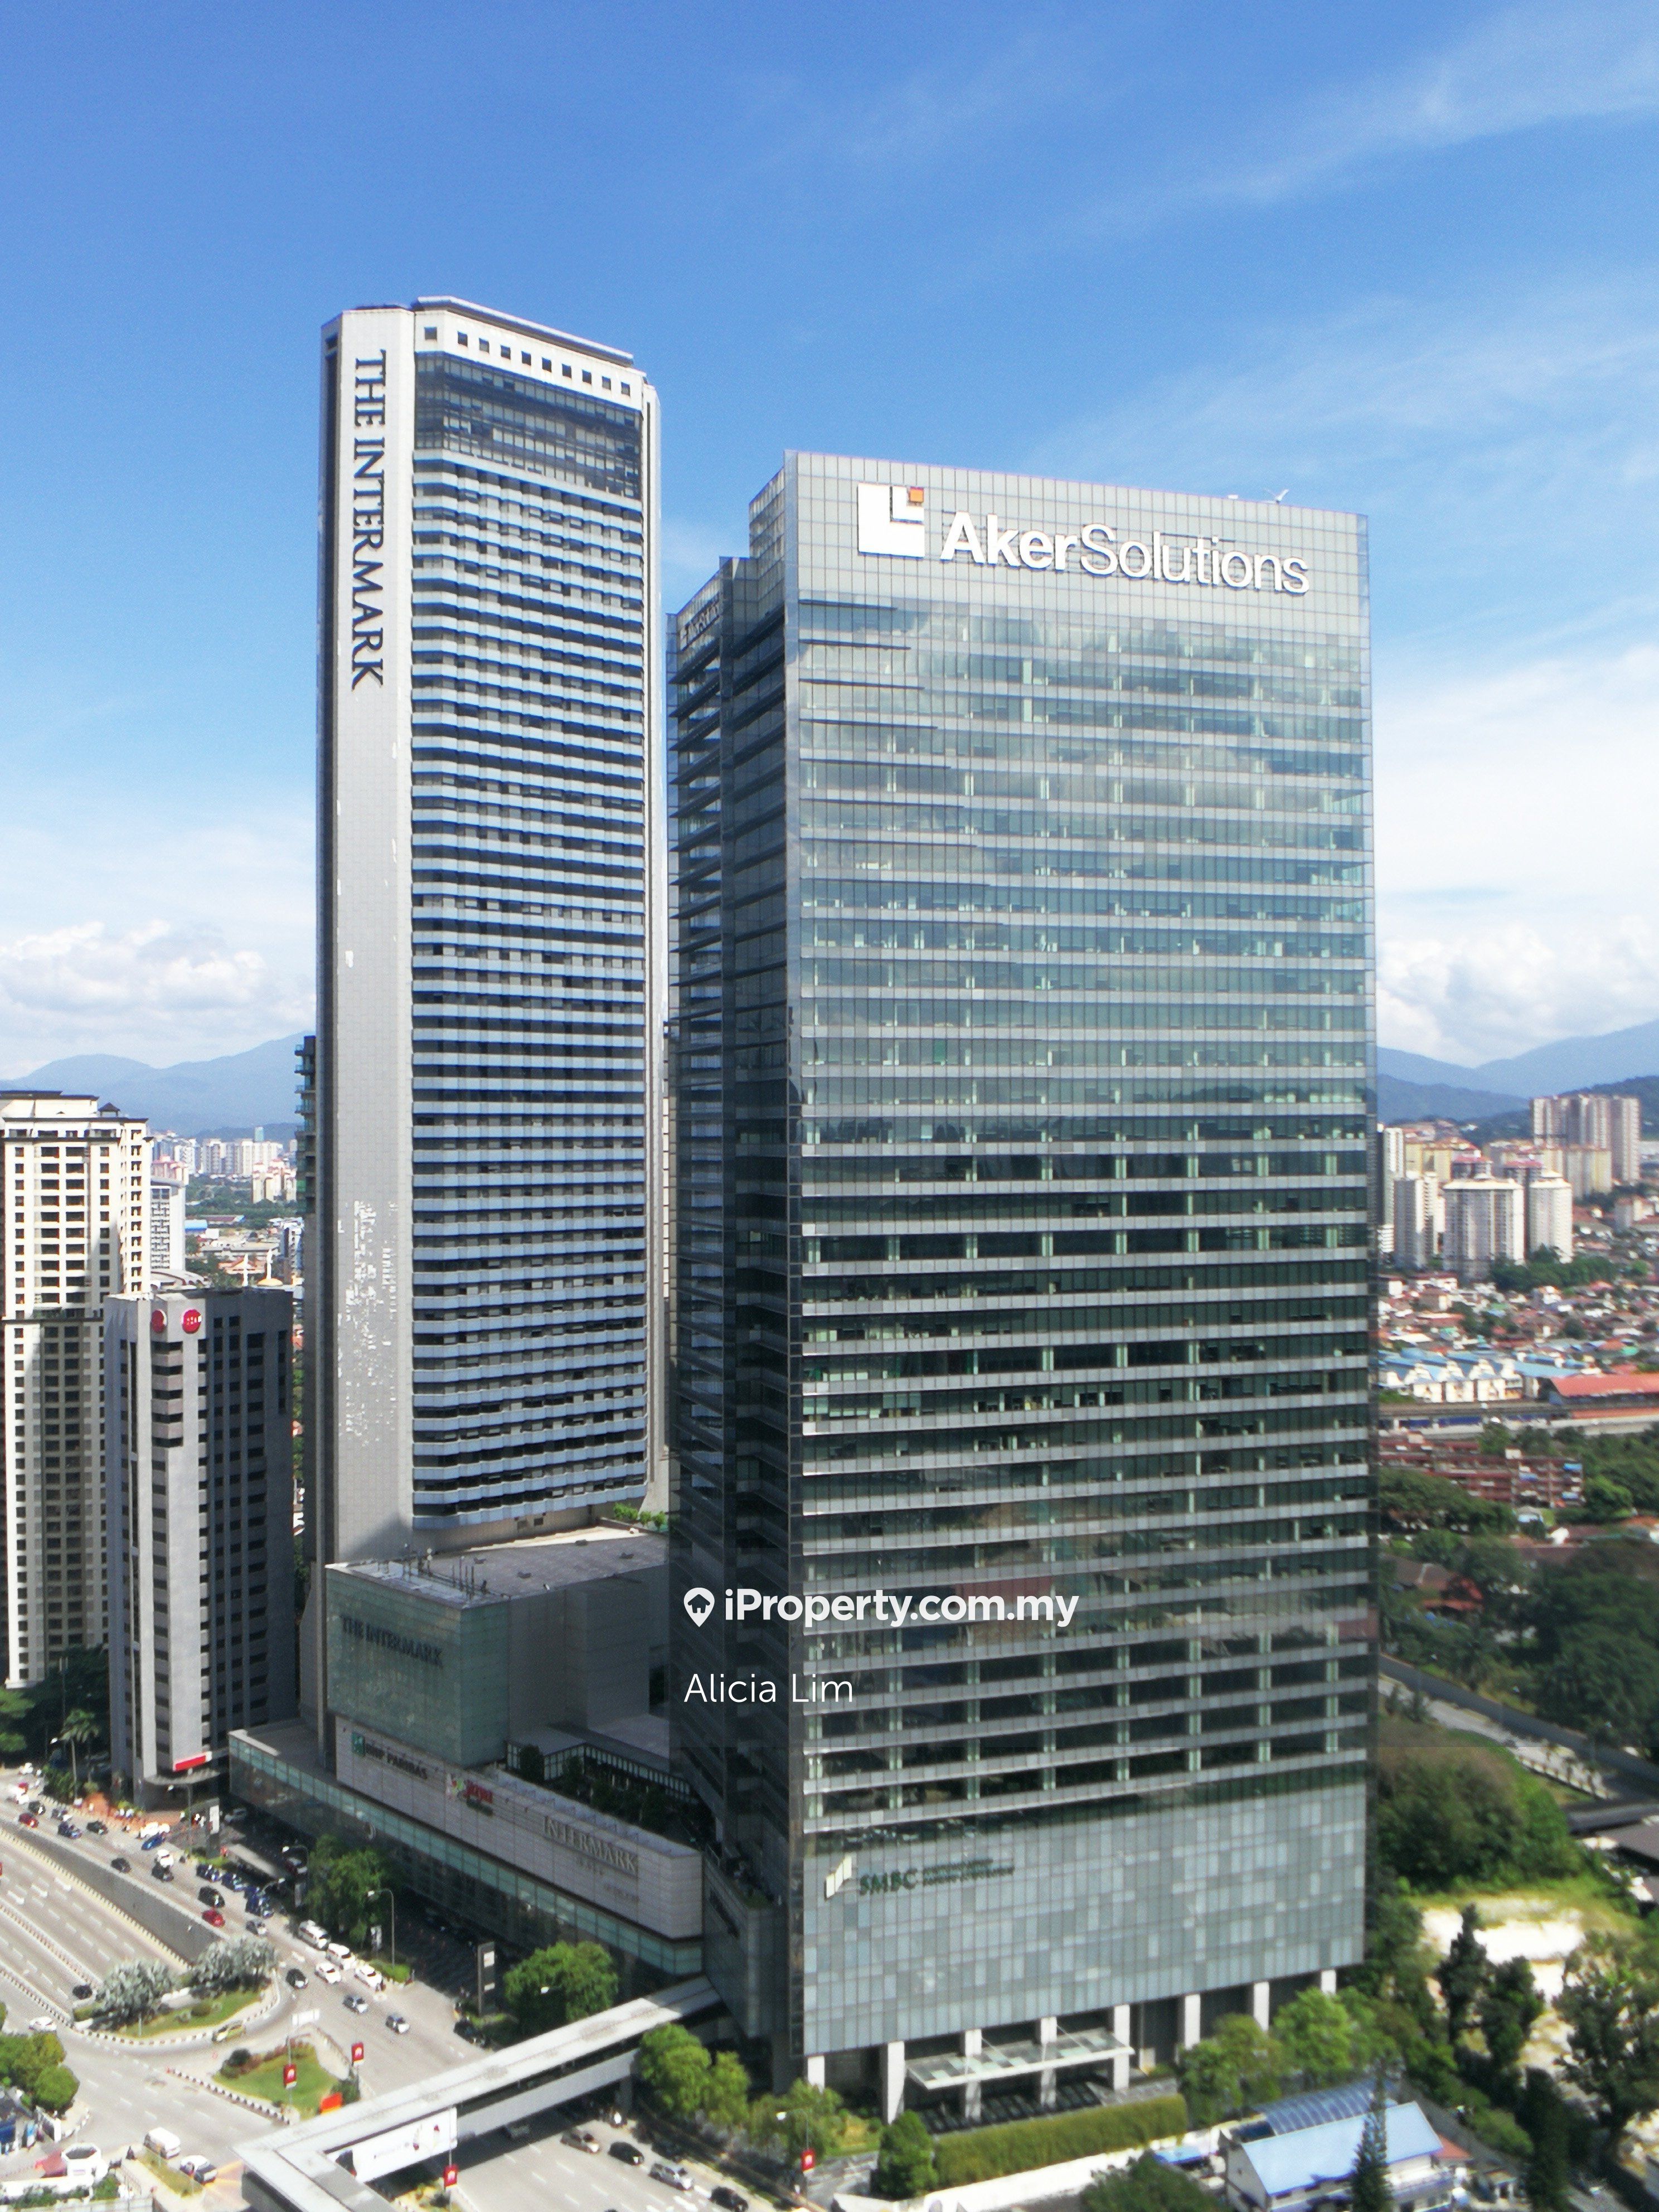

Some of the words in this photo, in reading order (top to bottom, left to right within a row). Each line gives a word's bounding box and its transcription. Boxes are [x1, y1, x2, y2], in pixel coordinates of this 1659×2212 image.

[355, 349, 386, 428] THE
[351, 438, 385, 690] INTERMARK
[860, 1867, 919, 1895] SMBC
